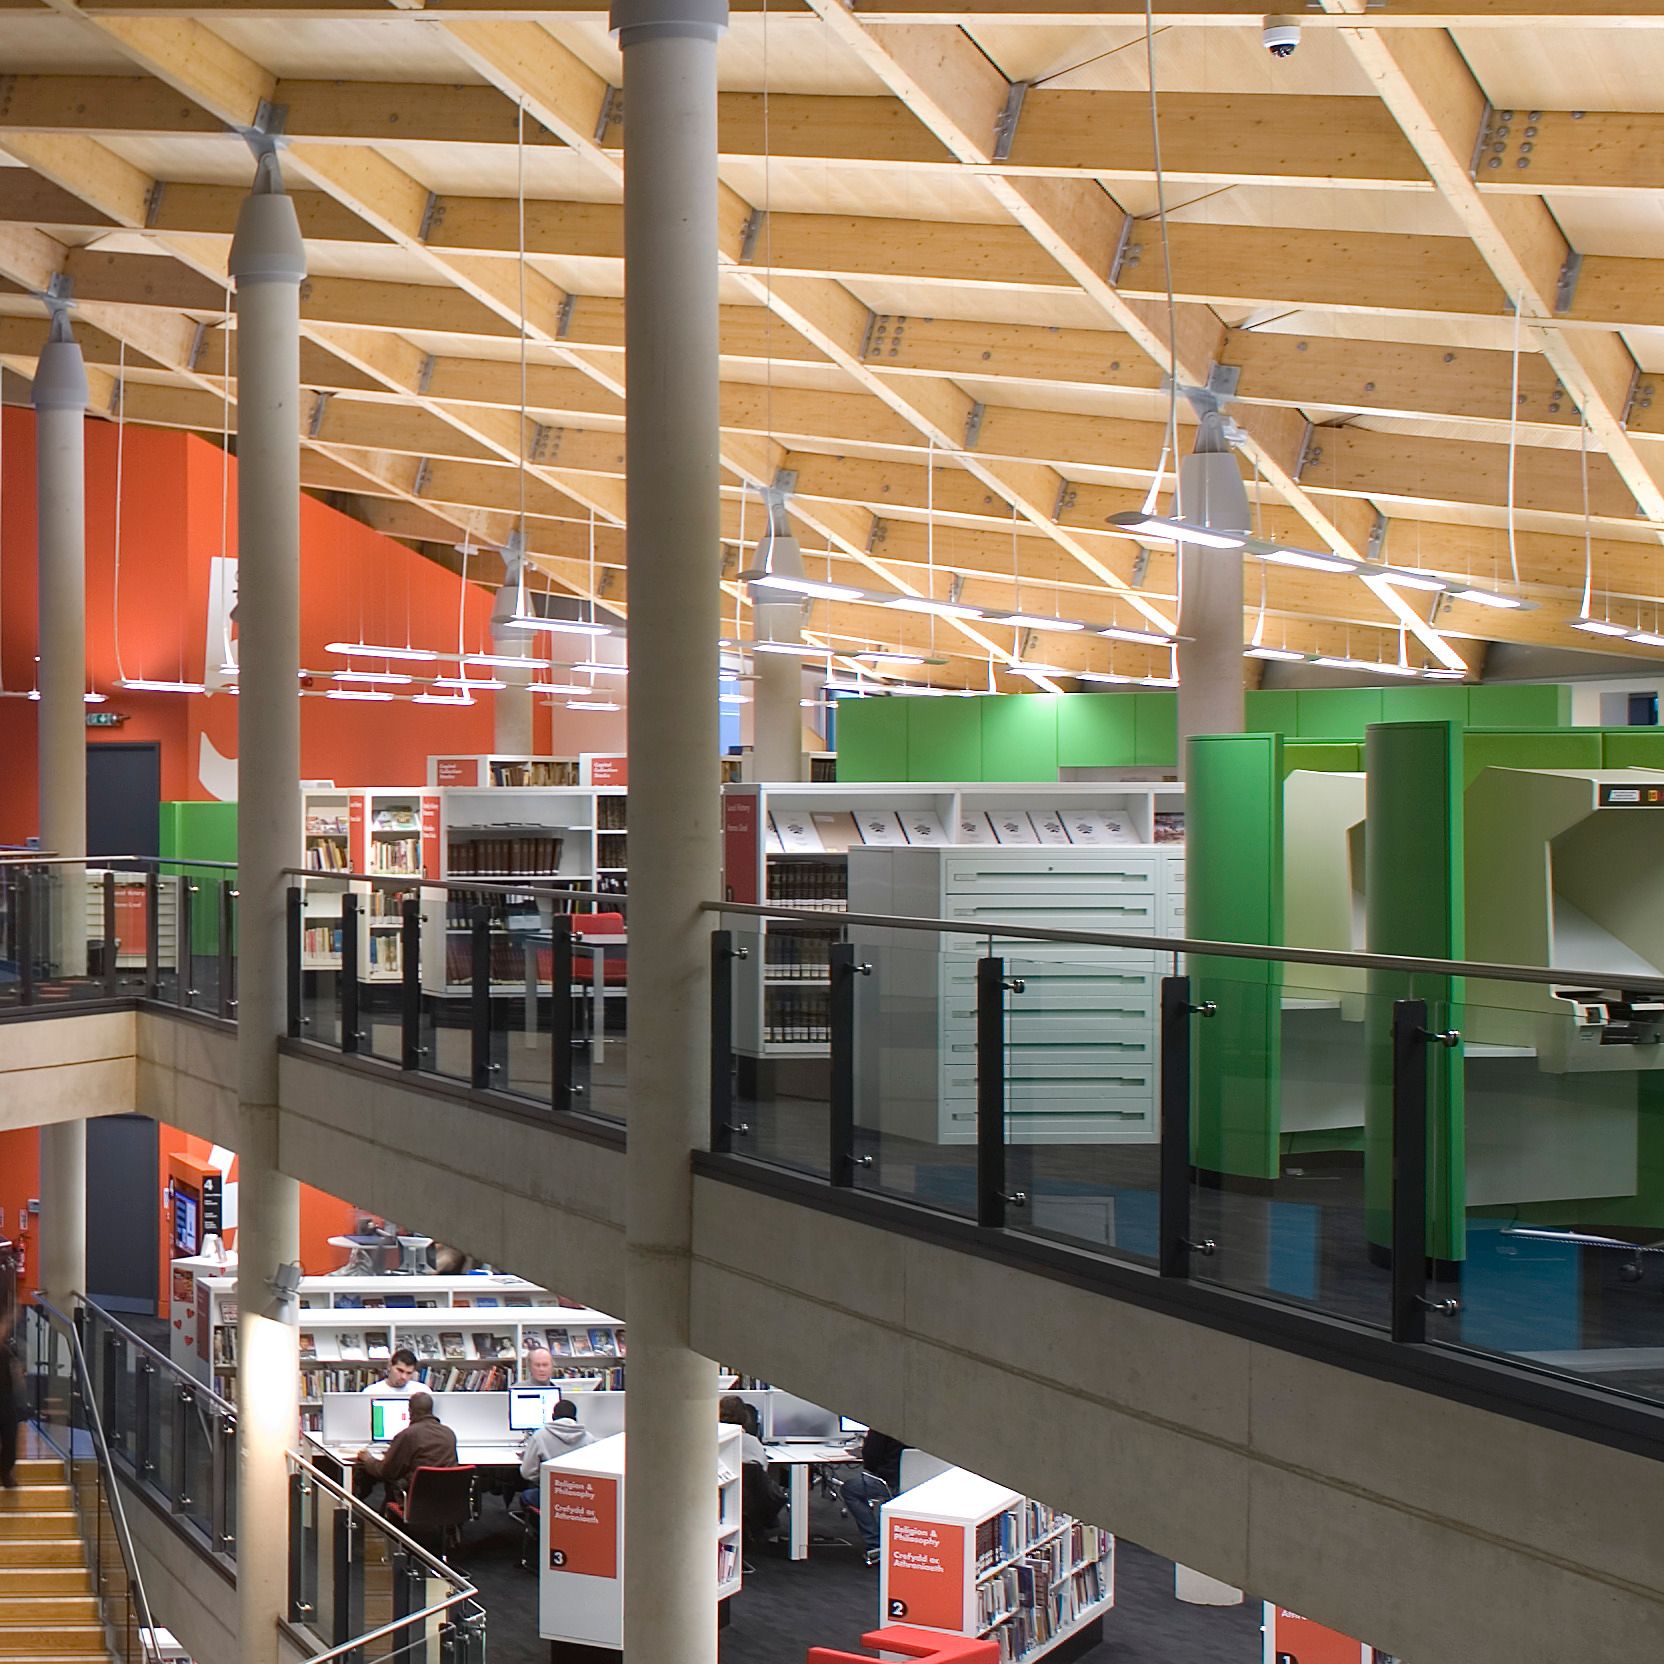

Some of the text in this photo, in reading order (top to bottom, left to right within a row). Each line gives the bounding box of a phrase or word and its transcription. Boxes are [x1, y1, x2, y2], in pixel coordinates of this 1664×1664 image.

[204, 1179, 214, 1191] 4
[554, 1487, 595, 1500] Philosophy
[893, 1525, 938, 1537] Religion &
[893, 1533, 940, 1548] Philosophy
[553, 1551, 565, 1565] 3
[893, 1551, 928, 1564] Crefydd
[892, 1601, 904, 1616] 2
